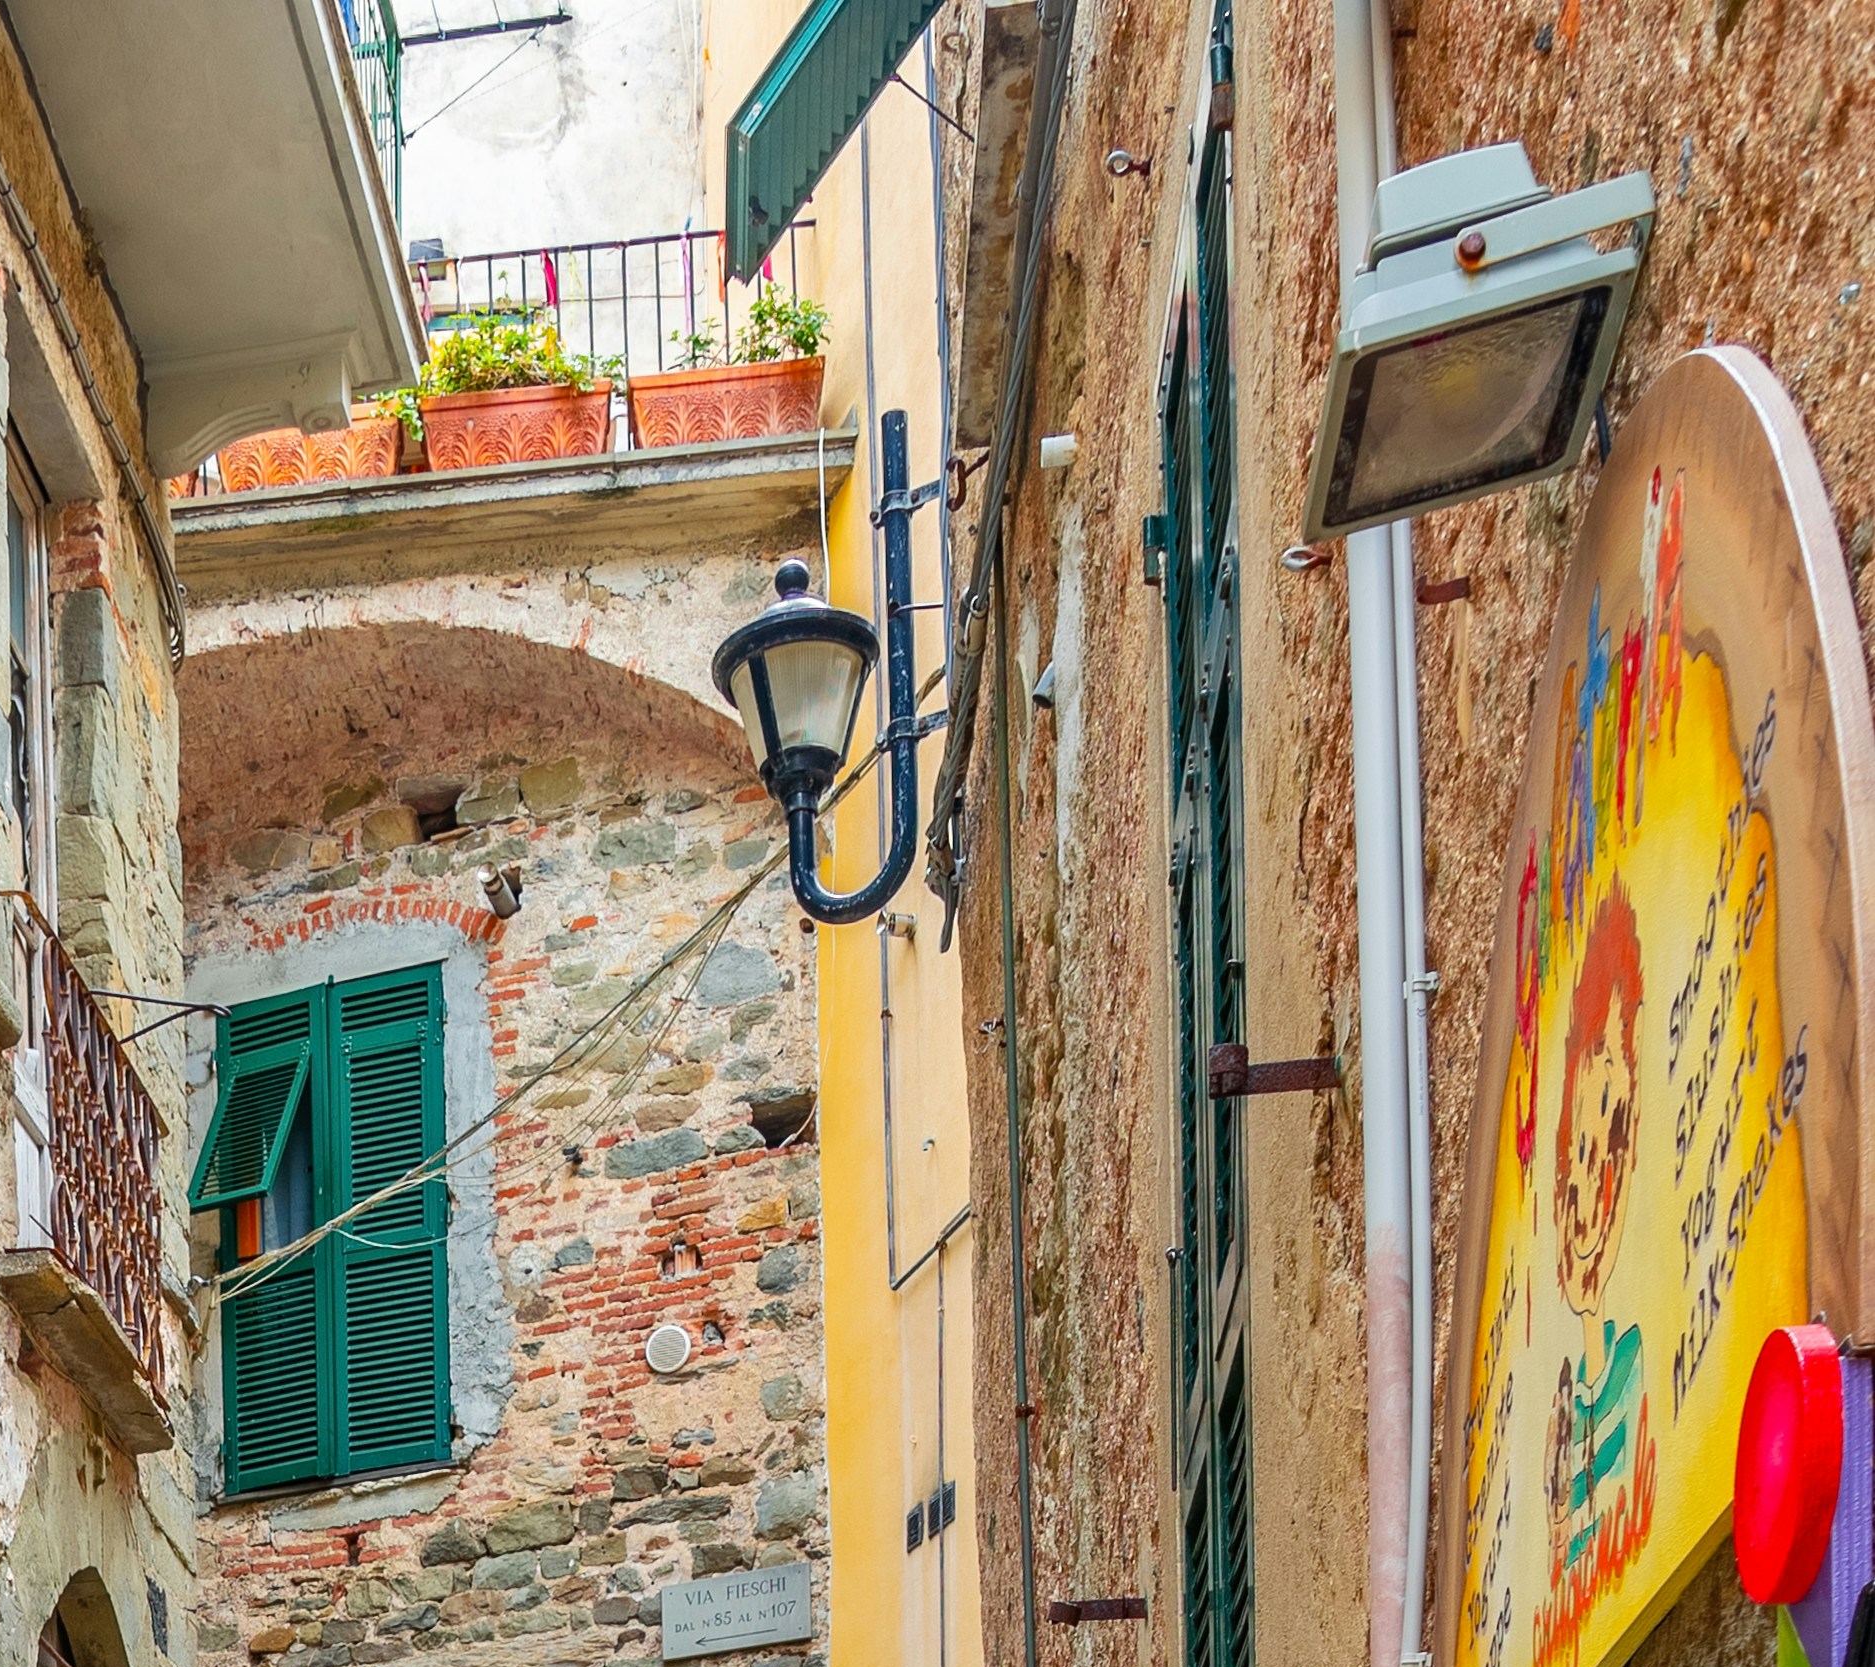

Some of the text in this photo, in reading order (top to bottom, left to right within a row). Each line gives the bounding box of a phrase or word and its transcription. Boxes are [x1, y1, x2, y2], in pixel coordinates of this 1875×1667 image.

[685, 1576, 786, 1606] VIA FIESCHI
[675, 1622, 695, 1634] DAL
[738, 1613, 752, 1624] AL
